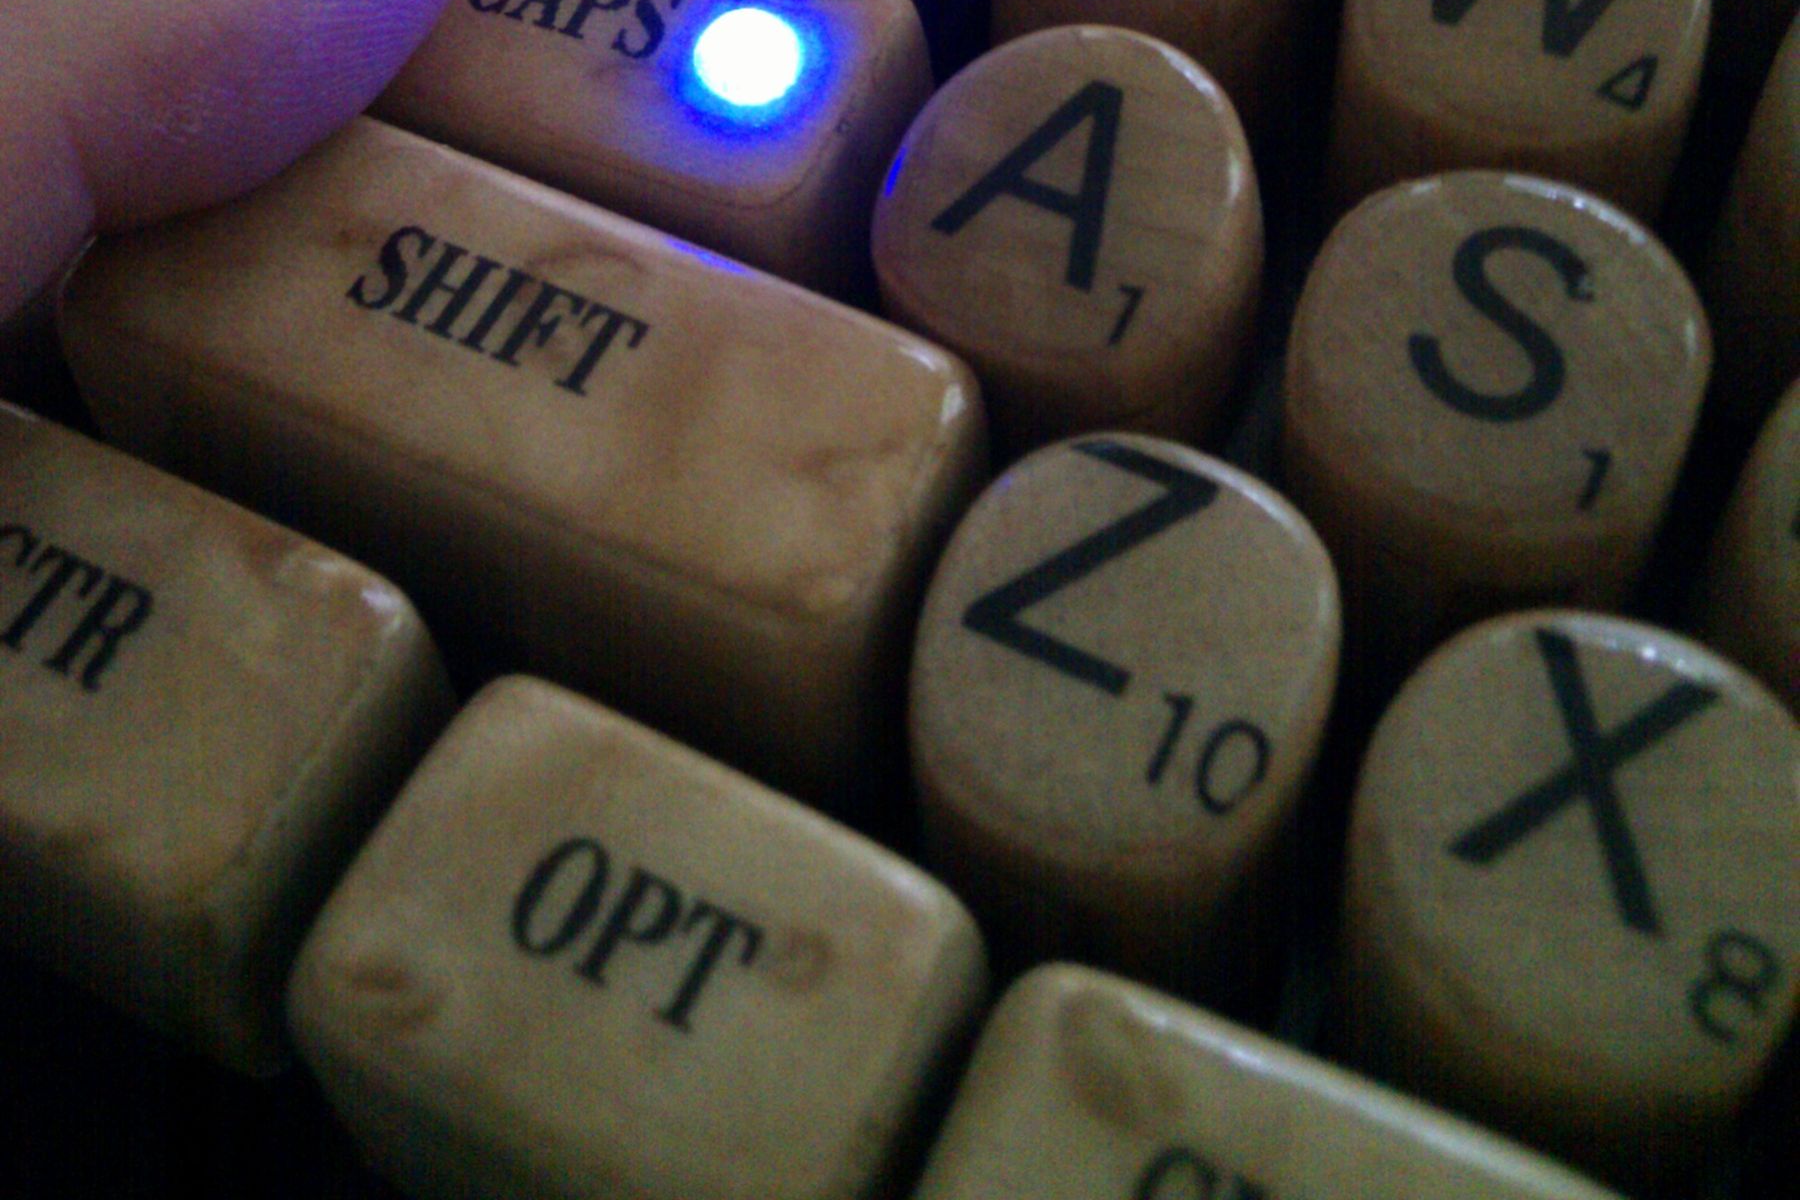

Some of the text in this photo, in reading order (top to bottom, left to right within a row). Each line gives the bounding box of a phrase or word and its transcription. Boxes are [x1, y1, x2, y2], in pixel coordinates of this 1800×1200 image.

[930, 79, 1125, 293] A
[345, 225, 649, 398] SHIFT
[1105, 283, 1145, 348] 1
[1406, 225, 1596, 424] S
[961, 437, 1220, 699] Z
[1576, 448, 1612, 513] 1
[1143, 691, 1272, 817] 10
[1446, 627, 1721, 937] X
[511, 834, 764, 1034] OPT
